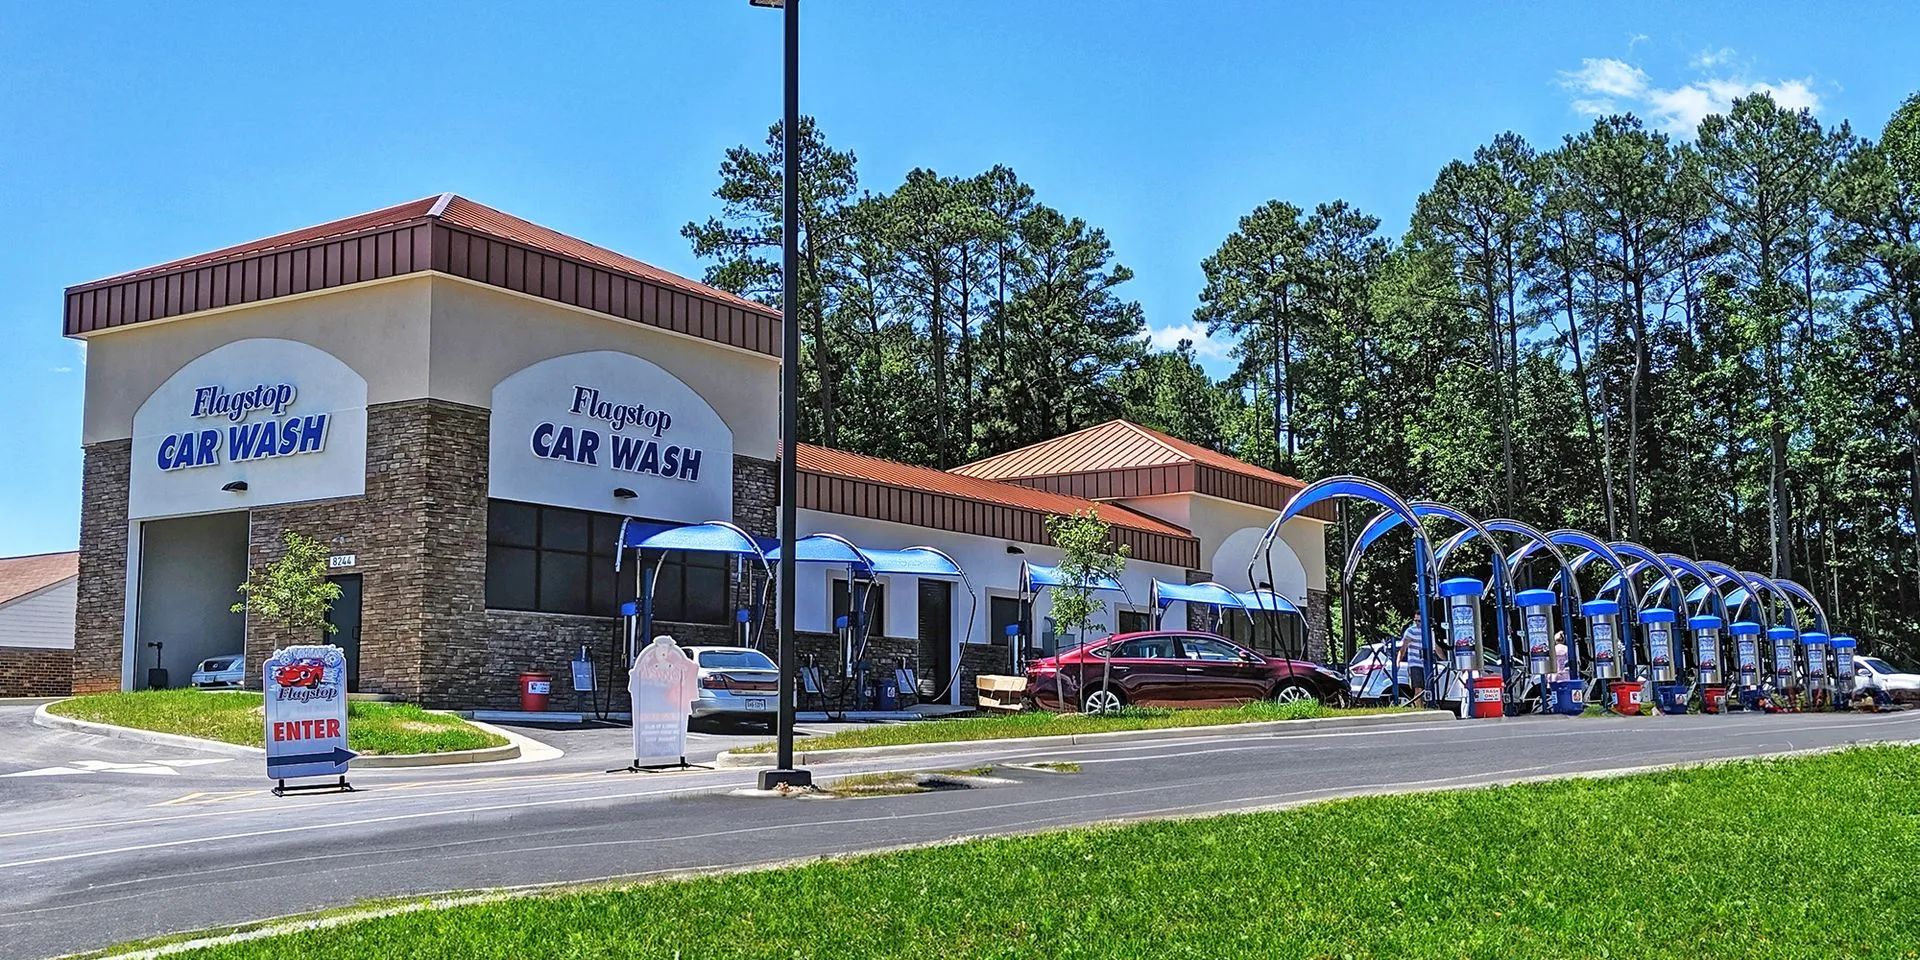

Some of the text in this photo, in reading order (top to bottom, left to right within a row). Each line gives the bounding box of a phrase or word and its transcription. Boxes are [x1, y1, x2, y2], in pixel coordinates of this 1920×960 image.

[191, 383, 295, 421] Flagstop
[570, 386, 672, 437] Flagstop
[157, 413, 328, 471] CAR WASH
[531, 423, 702, 481] CAR WASH
[333, 556, 352, 566] 8244
[276, 687, 338, 703] Flagstop
[273, 718, 341, 742] ENTER
